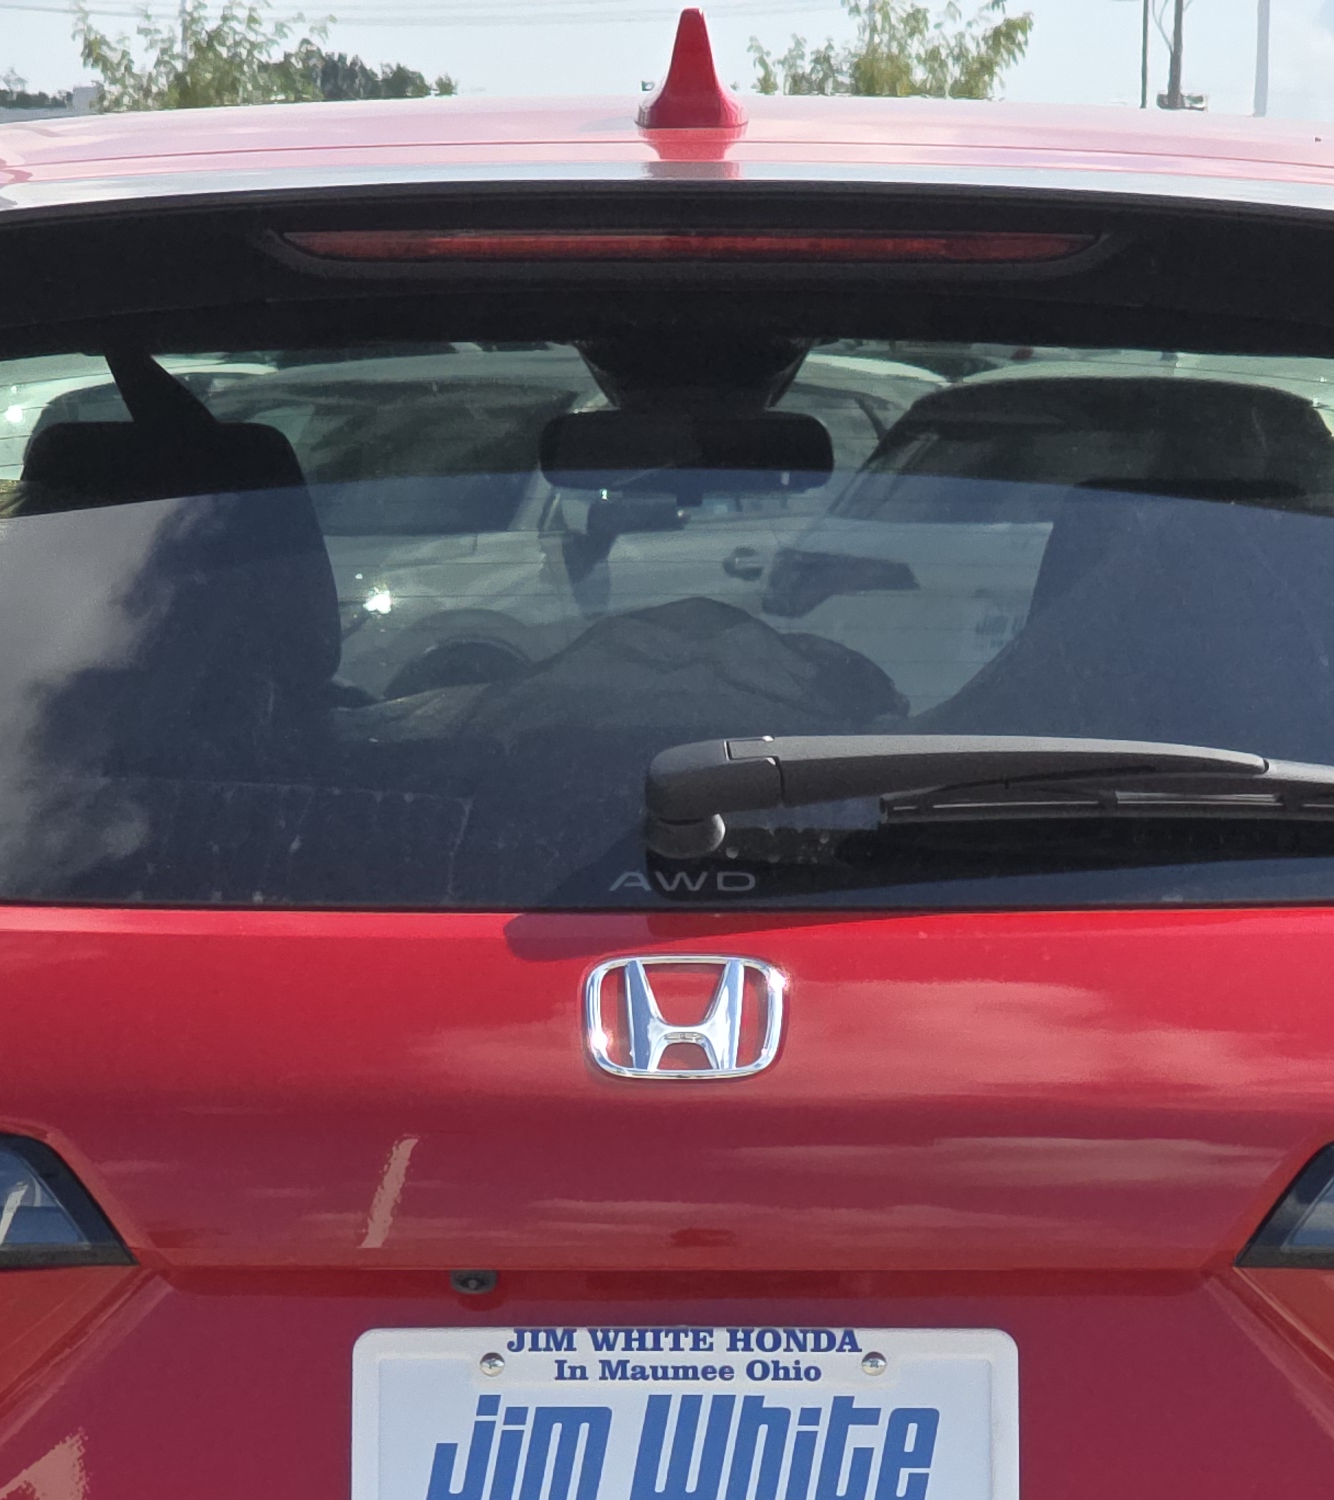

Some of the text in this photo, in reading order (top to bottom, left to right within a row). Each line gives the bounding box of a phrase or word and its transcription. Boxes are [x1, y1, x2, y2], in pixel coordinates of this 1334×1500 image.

[609, 871, 756, 892] AWD
[507, 1328, 863, 1352] JIM WHITE HONDA
[554, 1359, 822, 1382] In Maumee Ohio
